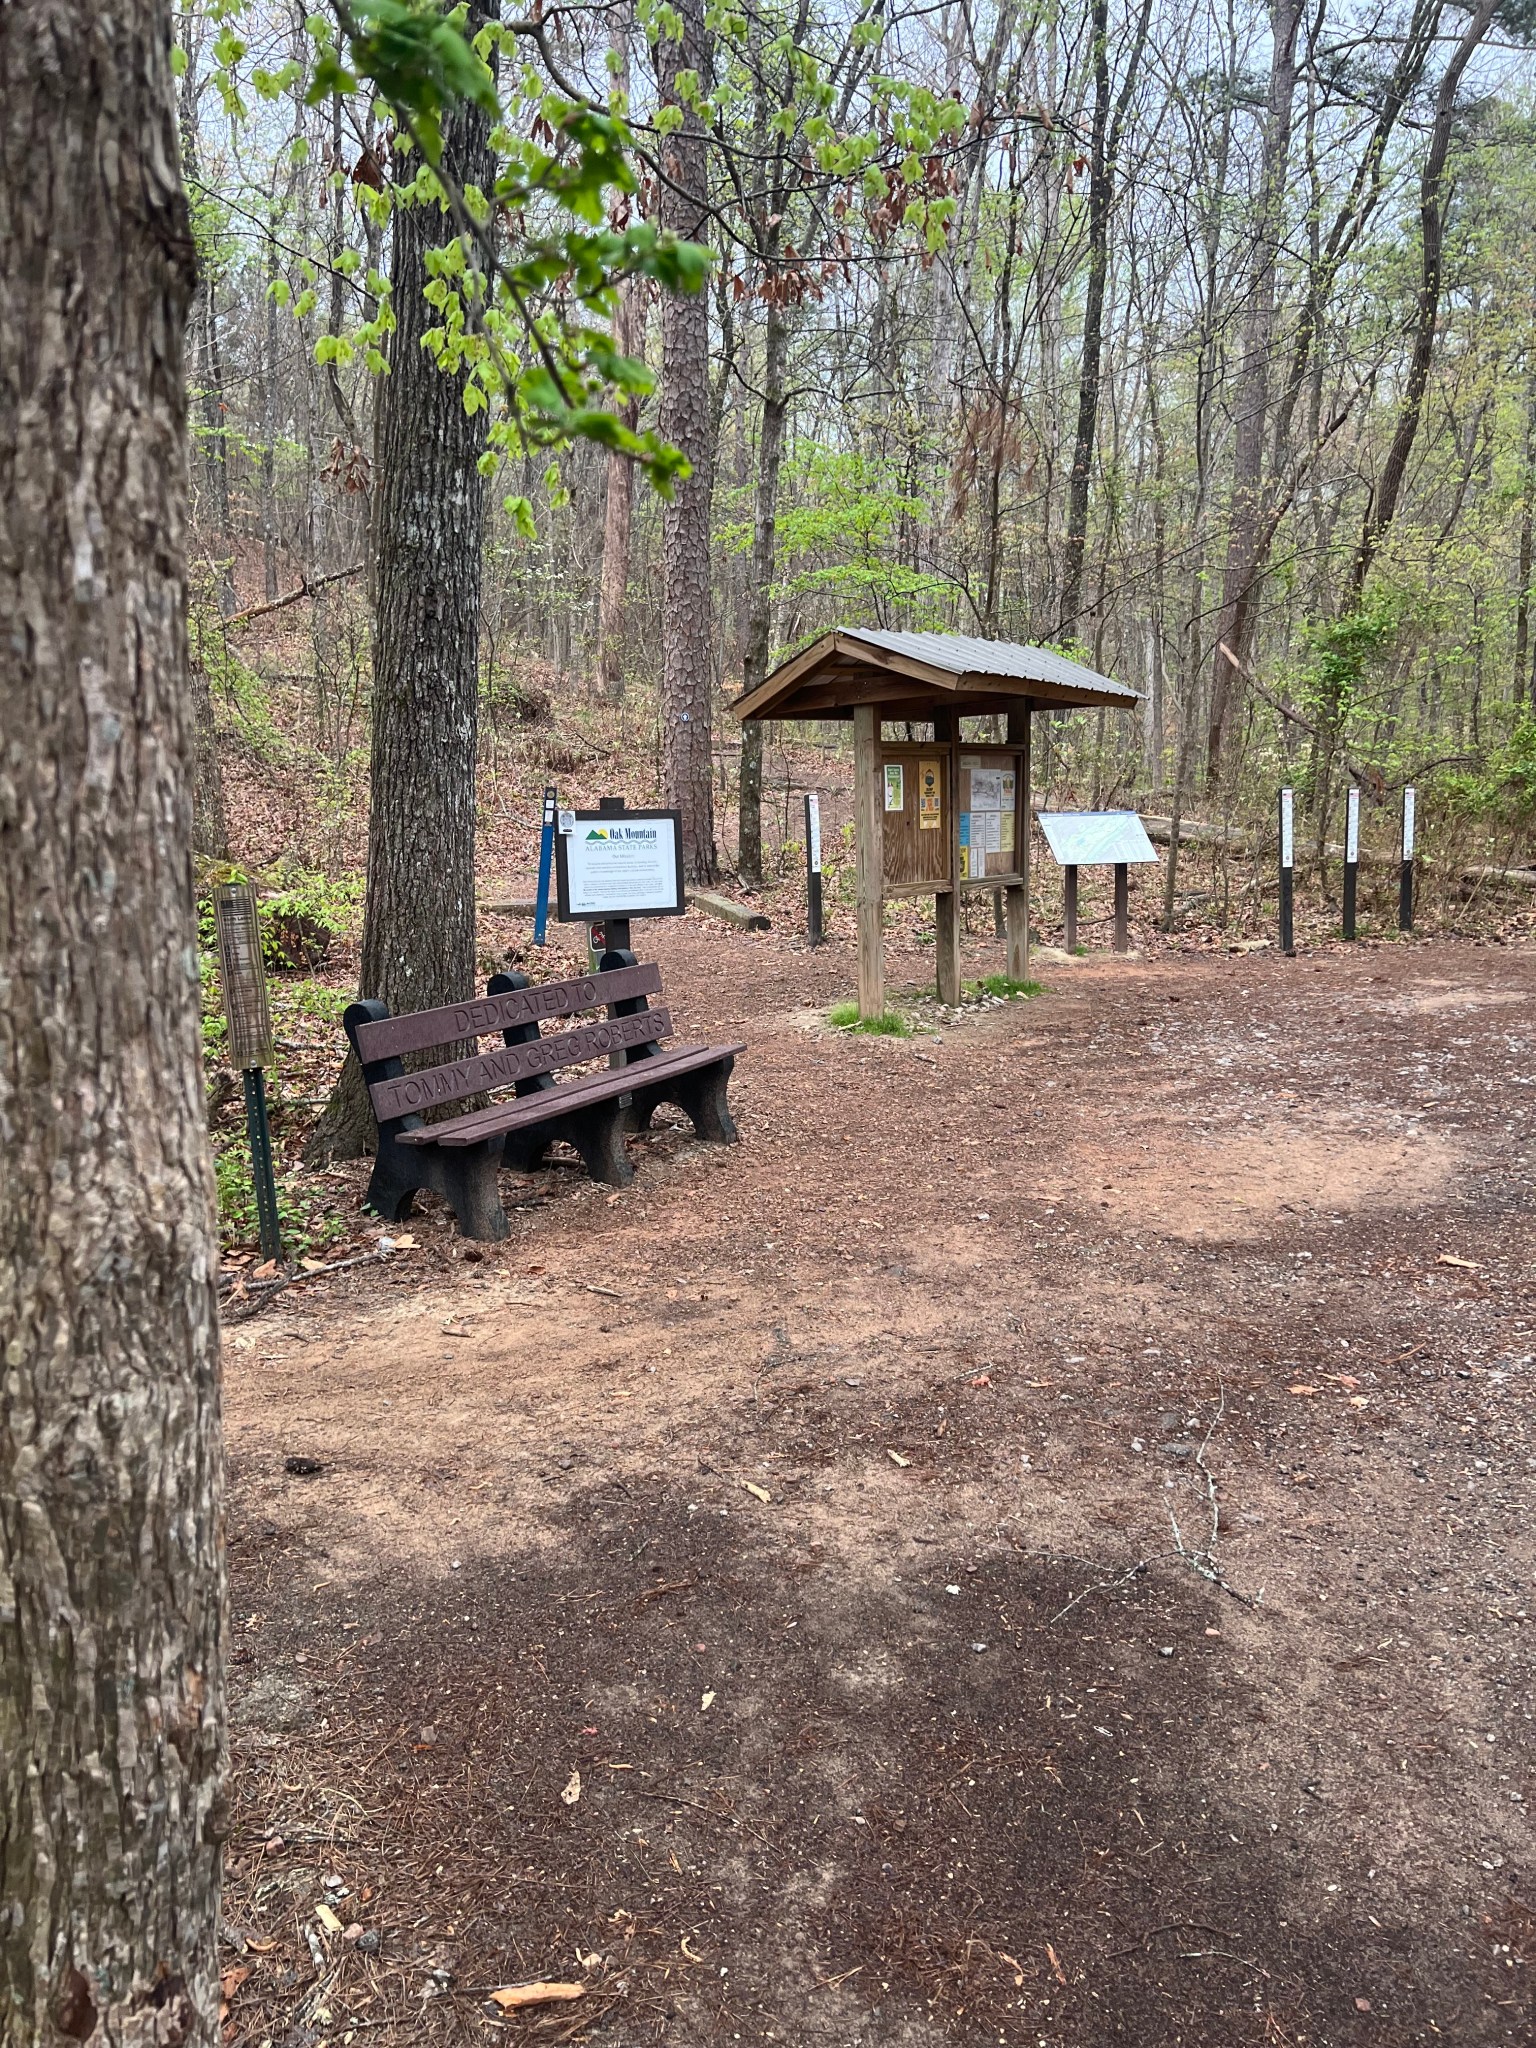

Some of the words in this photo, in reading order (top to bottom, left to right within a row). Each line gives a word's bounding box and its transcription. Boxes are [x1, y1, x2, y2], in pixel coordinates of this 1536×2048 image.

[610, 828, 623, 839] Oak
[625, 828, 656, 839] Mountain
[454, 987, 569, 1032] DEDICATED
[571, 981, 597, 1004] TO
[388, 1065, 473, 1105] TOMMY
[479, 1052, 521, 1080] AND
[527, 1037, 582, 1069] GREG
[587, 1012, 665, 1049] ROBERTS
